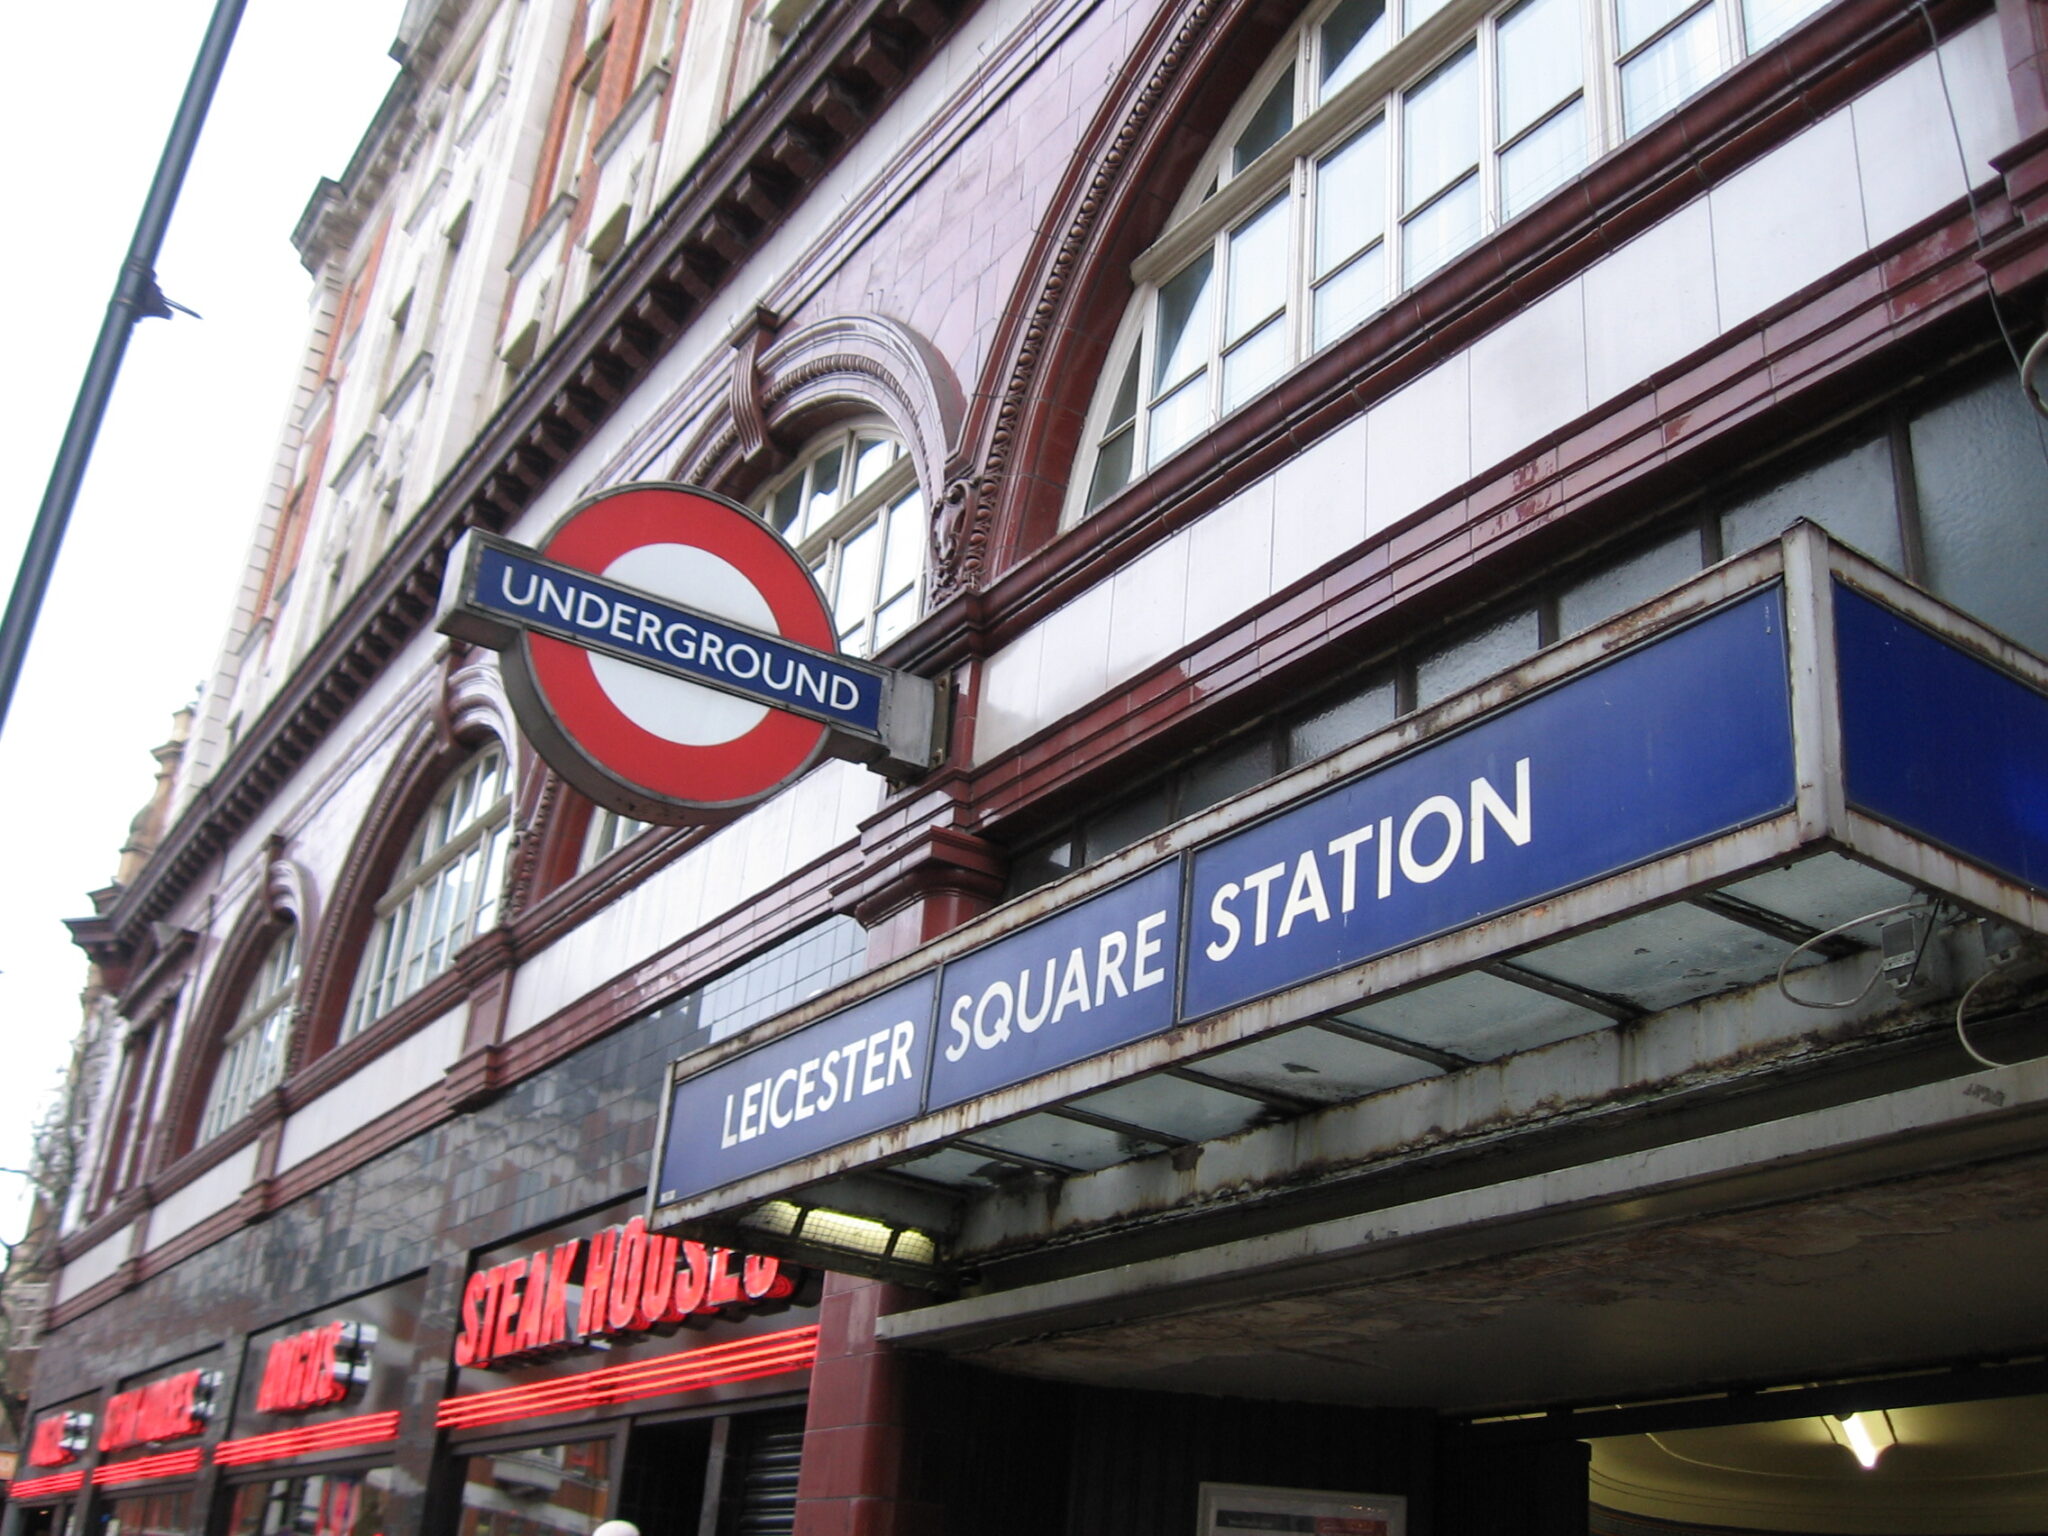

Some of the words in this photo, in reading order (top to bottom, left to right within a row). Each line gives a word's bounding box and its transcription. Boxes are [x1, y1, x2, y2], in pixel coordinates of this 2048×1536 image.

[501, 565, 860, 712] UNDERGROUND
[720, 1019, 916, 1150] LEICESTER
[945, 909, 1168, 1063] SQUARE
[1205, 756, 1532, 962] STATION
[455, 1237, 579, 1367] STEAK
